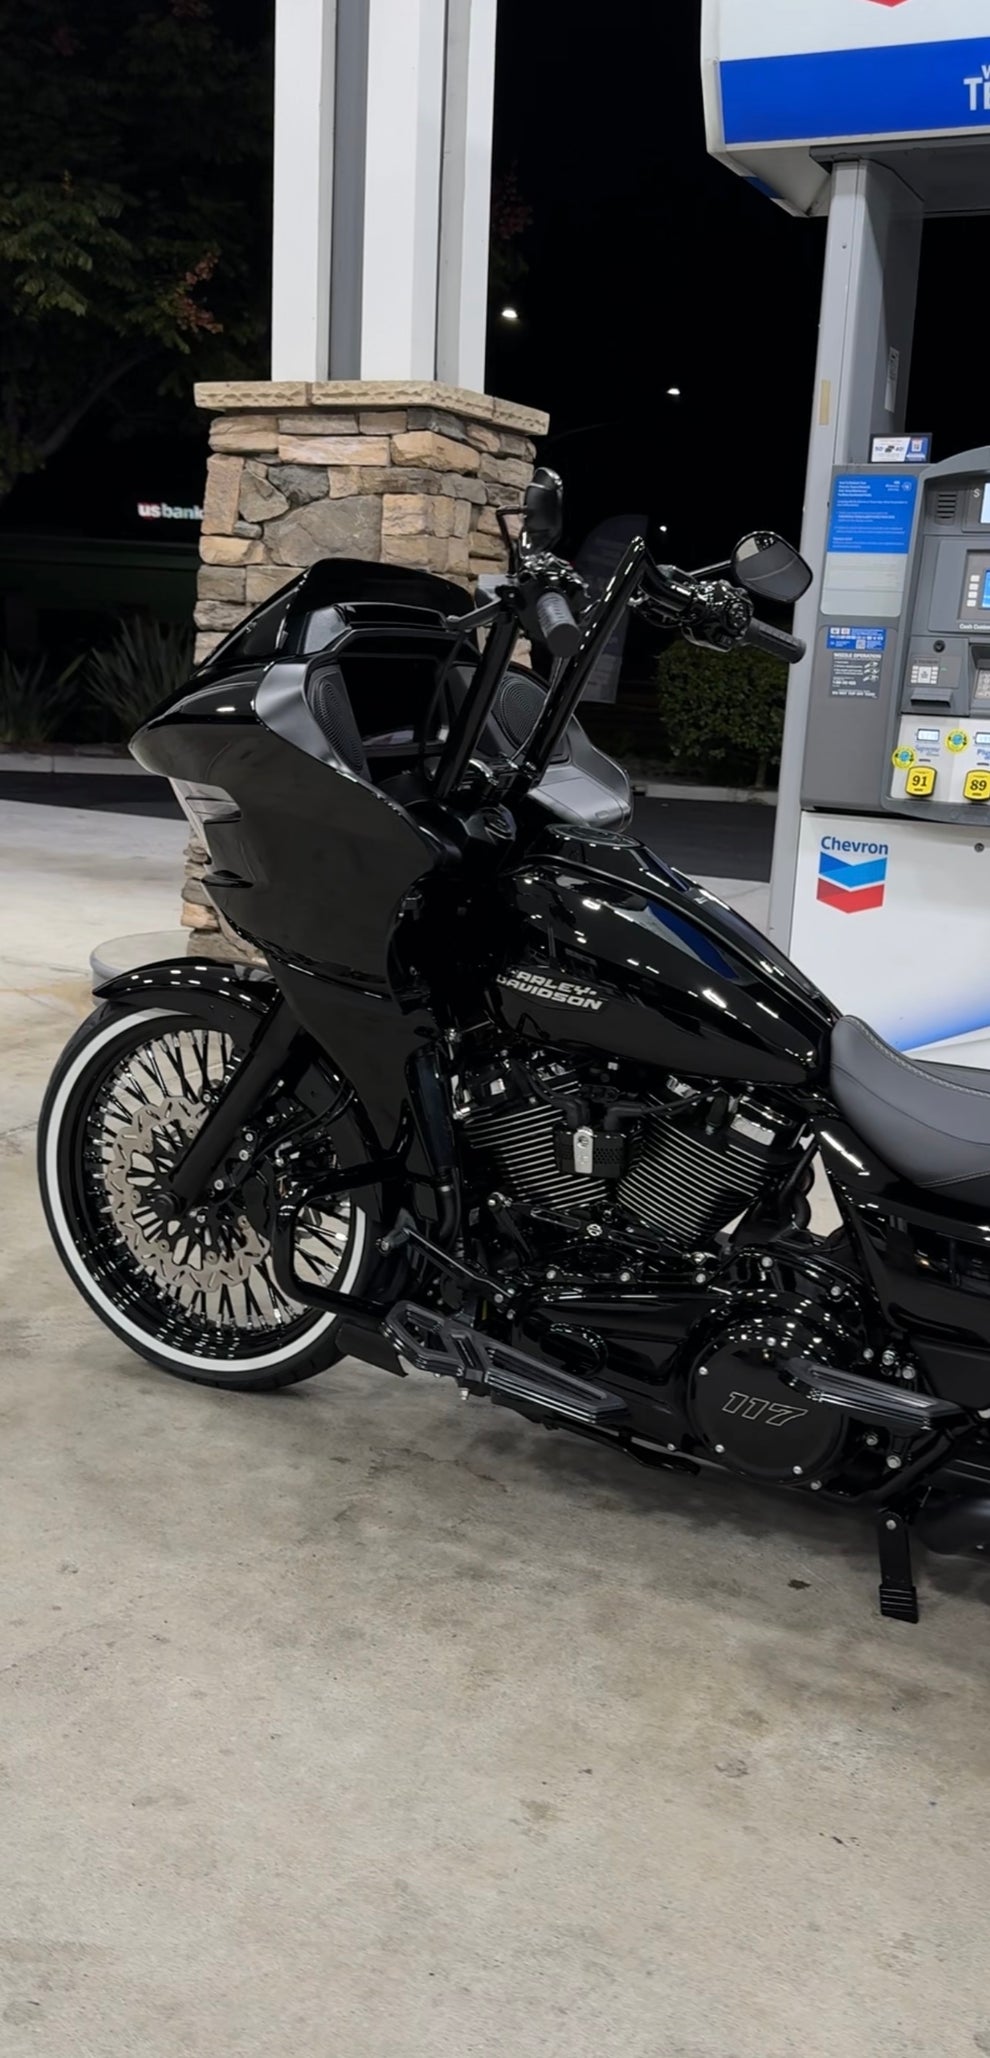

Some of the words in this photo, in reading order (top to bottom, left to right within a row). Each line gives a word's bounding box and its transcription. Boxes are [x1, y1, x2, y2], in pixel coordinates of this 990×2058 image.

[912, 775, 927, 787] 91
[969, 779, 987, 791] 89
[821, 835, 889, 855] Chevron
[496, 974, 603, 1010] DAVIDSON
[722, 1391, 808, 1426] 117
